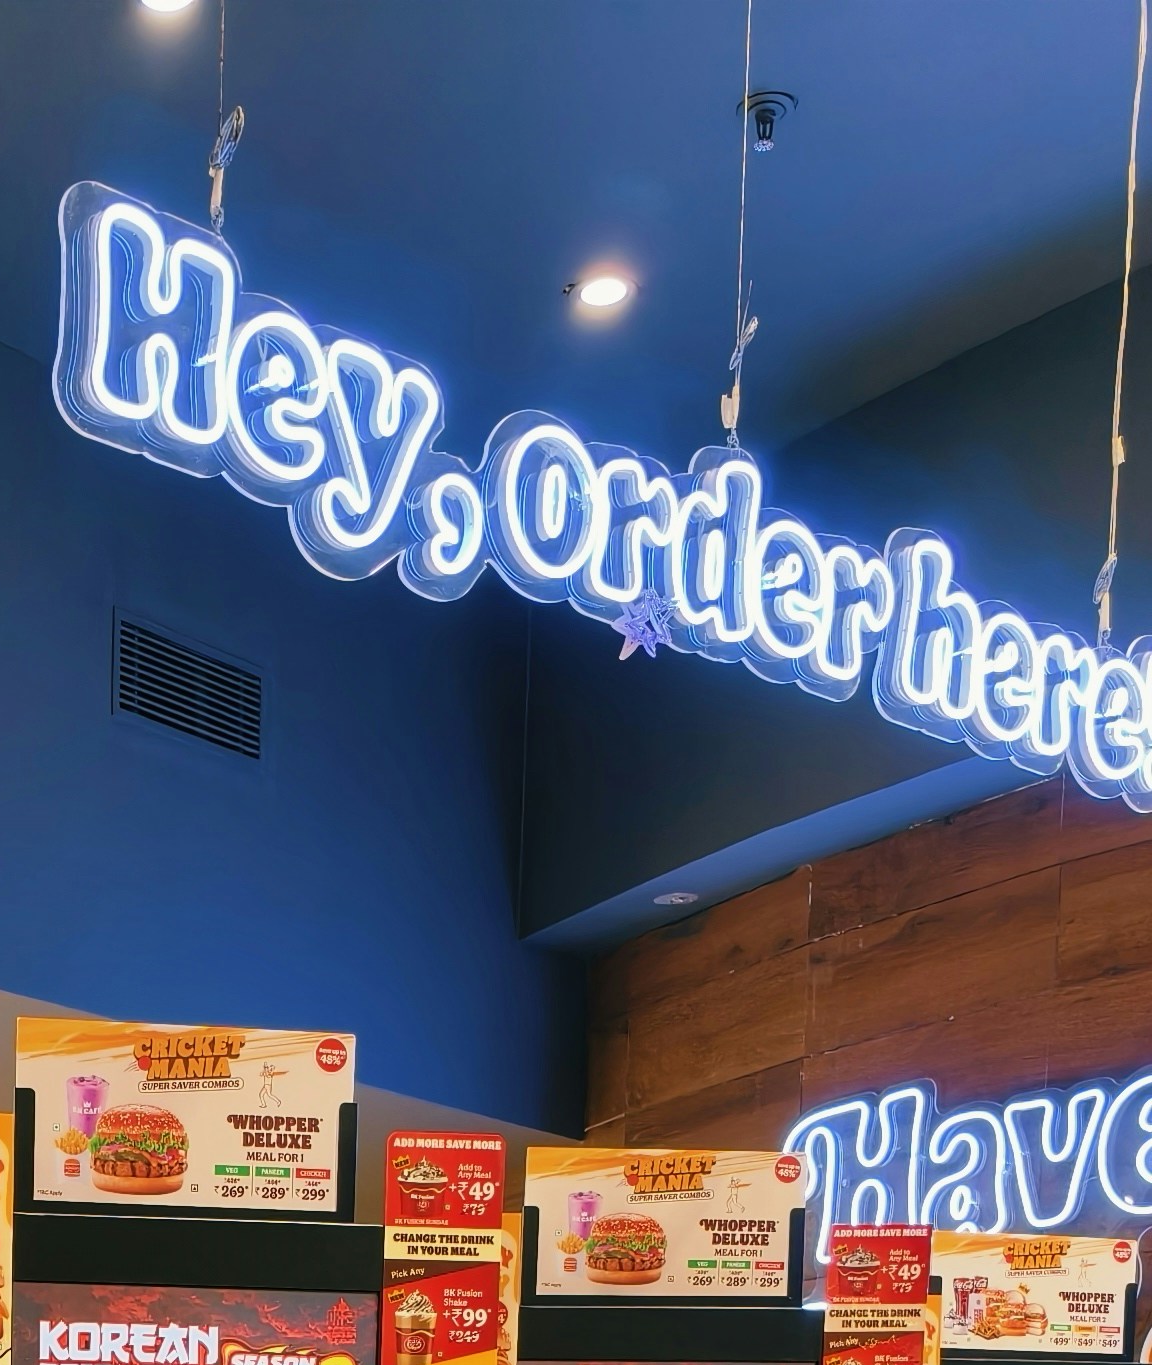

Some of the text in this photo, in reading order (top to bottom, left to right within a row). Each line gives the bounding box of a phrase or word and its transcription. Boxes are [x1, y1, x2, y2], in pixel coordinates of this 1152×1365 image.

[496, 424, 892, 680] Order
[133, 1034, 246, 1058] CRICKET
[146, 1056, 231, 1080] MANIA
[142, 1079, 240, 1091] SUPER SAVER COMBOS
[242, 1132, 312, 1149] DELUXE
[246, 1151, 296, 1162] MEAL FOR
[623, 1155, 716, 1176] CRICKET
[634, 1174, 703, 1194] MANIA
[393, 1233, 494, 1245] CHANGE THE DRINK
[712, 1232, 769, 1246] DELUXE
[407, 1246, 479, 1256] IN YOUR MEAL
[1067, 1303, 1110, 1314] DELUXE
[39, 1320, 219, 1365] KOREAN
